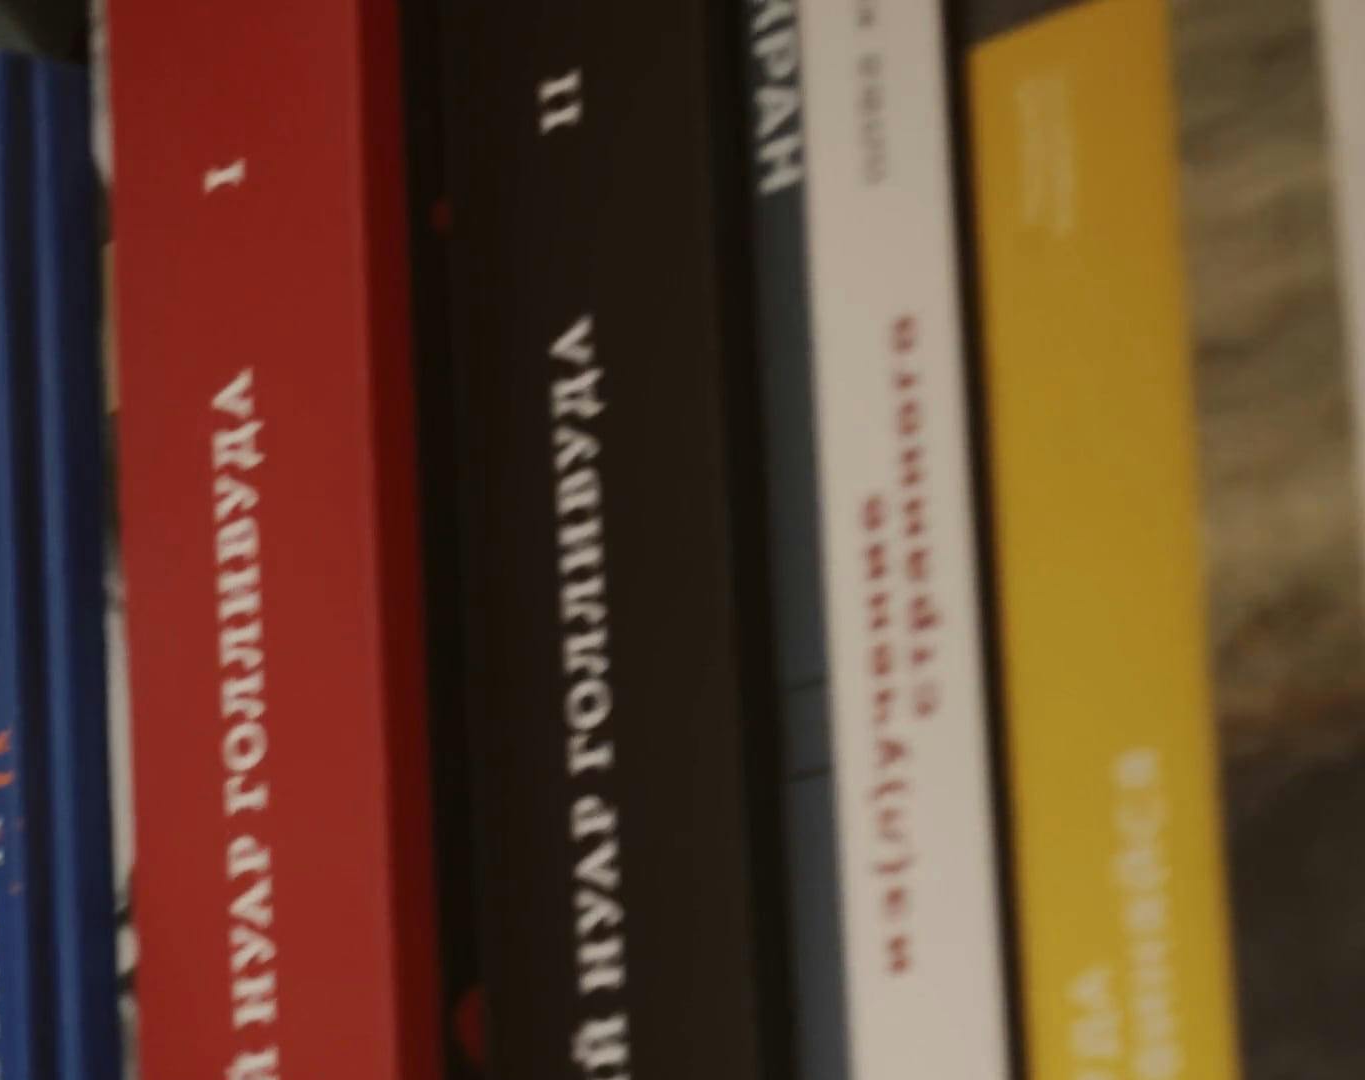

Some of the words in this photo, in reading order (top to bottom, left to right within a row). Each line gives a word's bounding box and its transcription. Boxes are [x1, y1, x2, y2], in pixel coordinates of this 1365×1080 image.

[209, 366, 269, 818] ГОЛЛИВУДА
[549, 314, 615, 779] ГОЛЛИВУДА
[225, 837, 279, 1030] НУАР
[567, 795, 627, 996] НУАР
